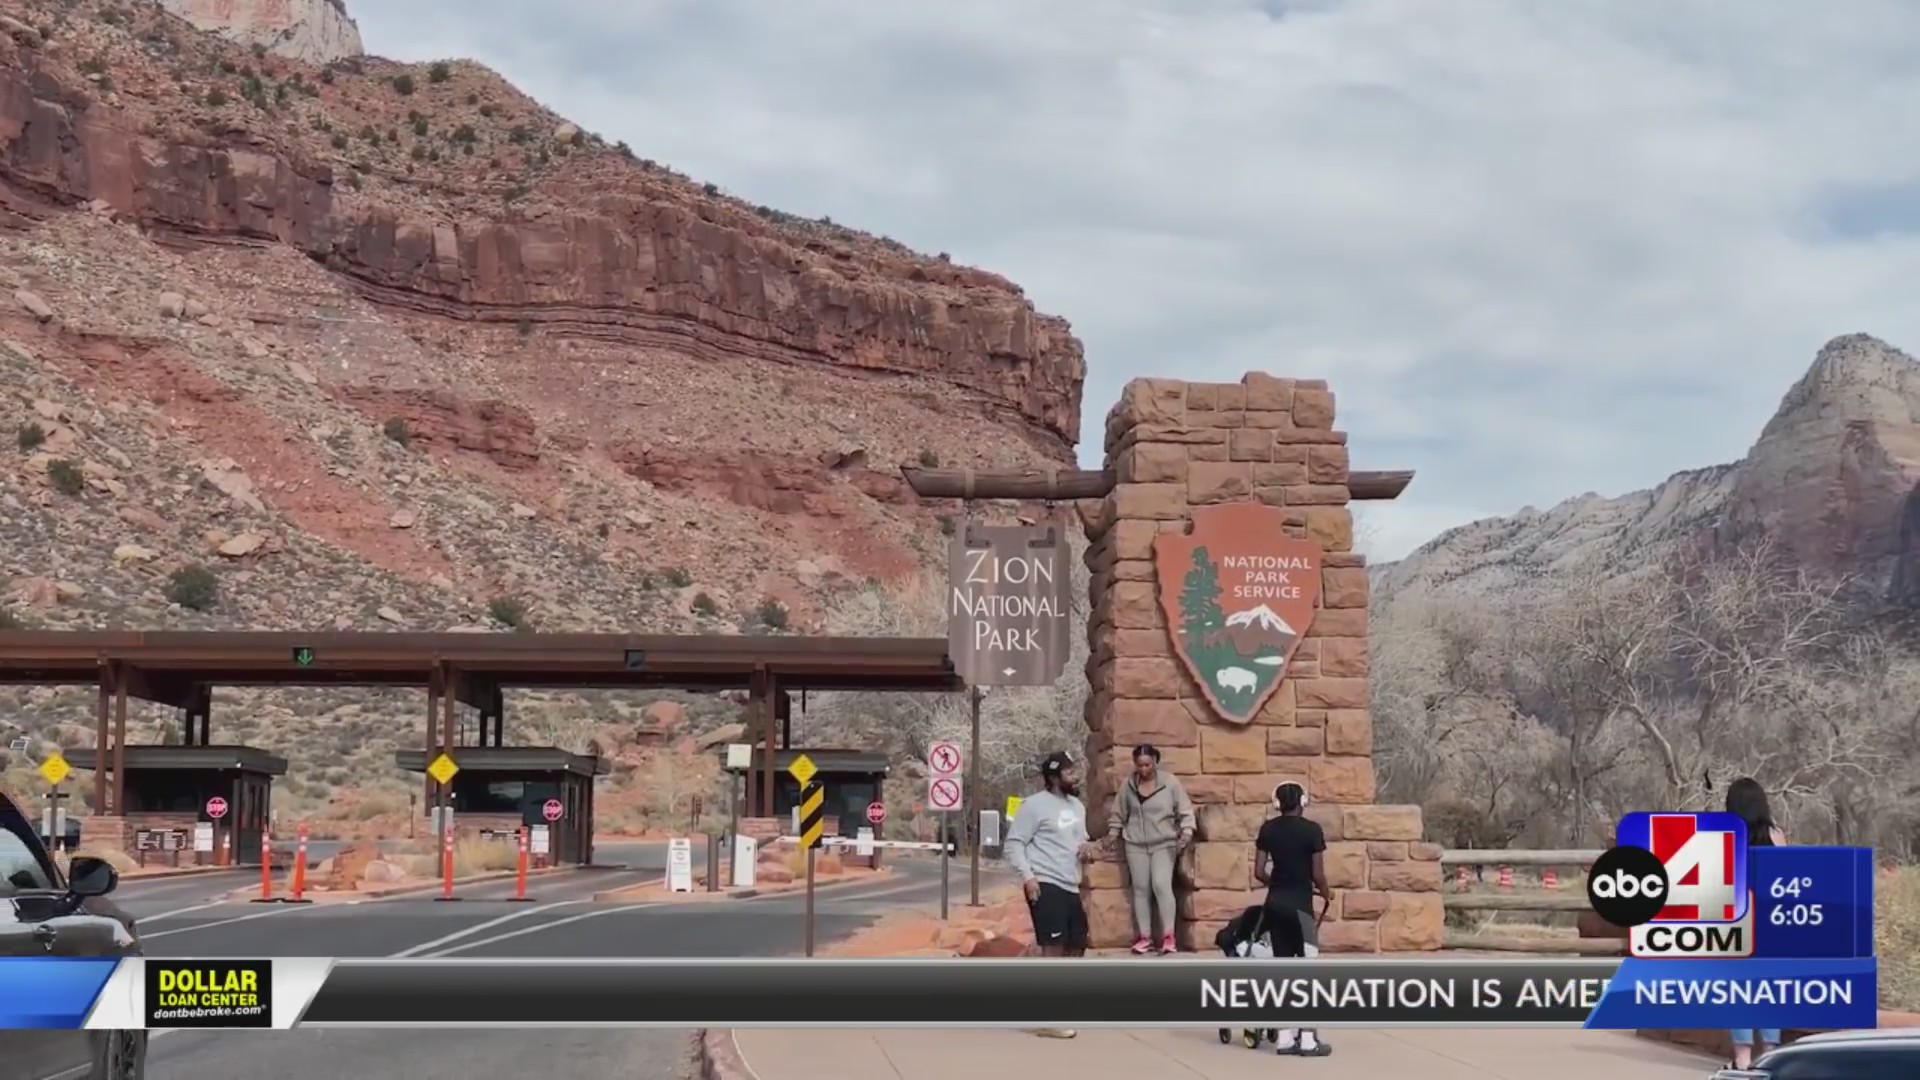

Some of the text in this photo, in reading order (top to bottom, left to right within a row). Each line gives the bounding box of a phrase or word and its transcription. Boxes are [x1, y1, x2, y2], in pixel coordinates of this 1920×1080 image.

[964, 549, 1053, 584] ZION
[1223, 556, 1312, 570] NATIONAL
[1245, 570, 1291, 584] PARK
[953, 586, 1066, 618] NATIONAL
[1233, 585, 1301, 599] SERVICE
[975, 620, 1042, 651] PARK
